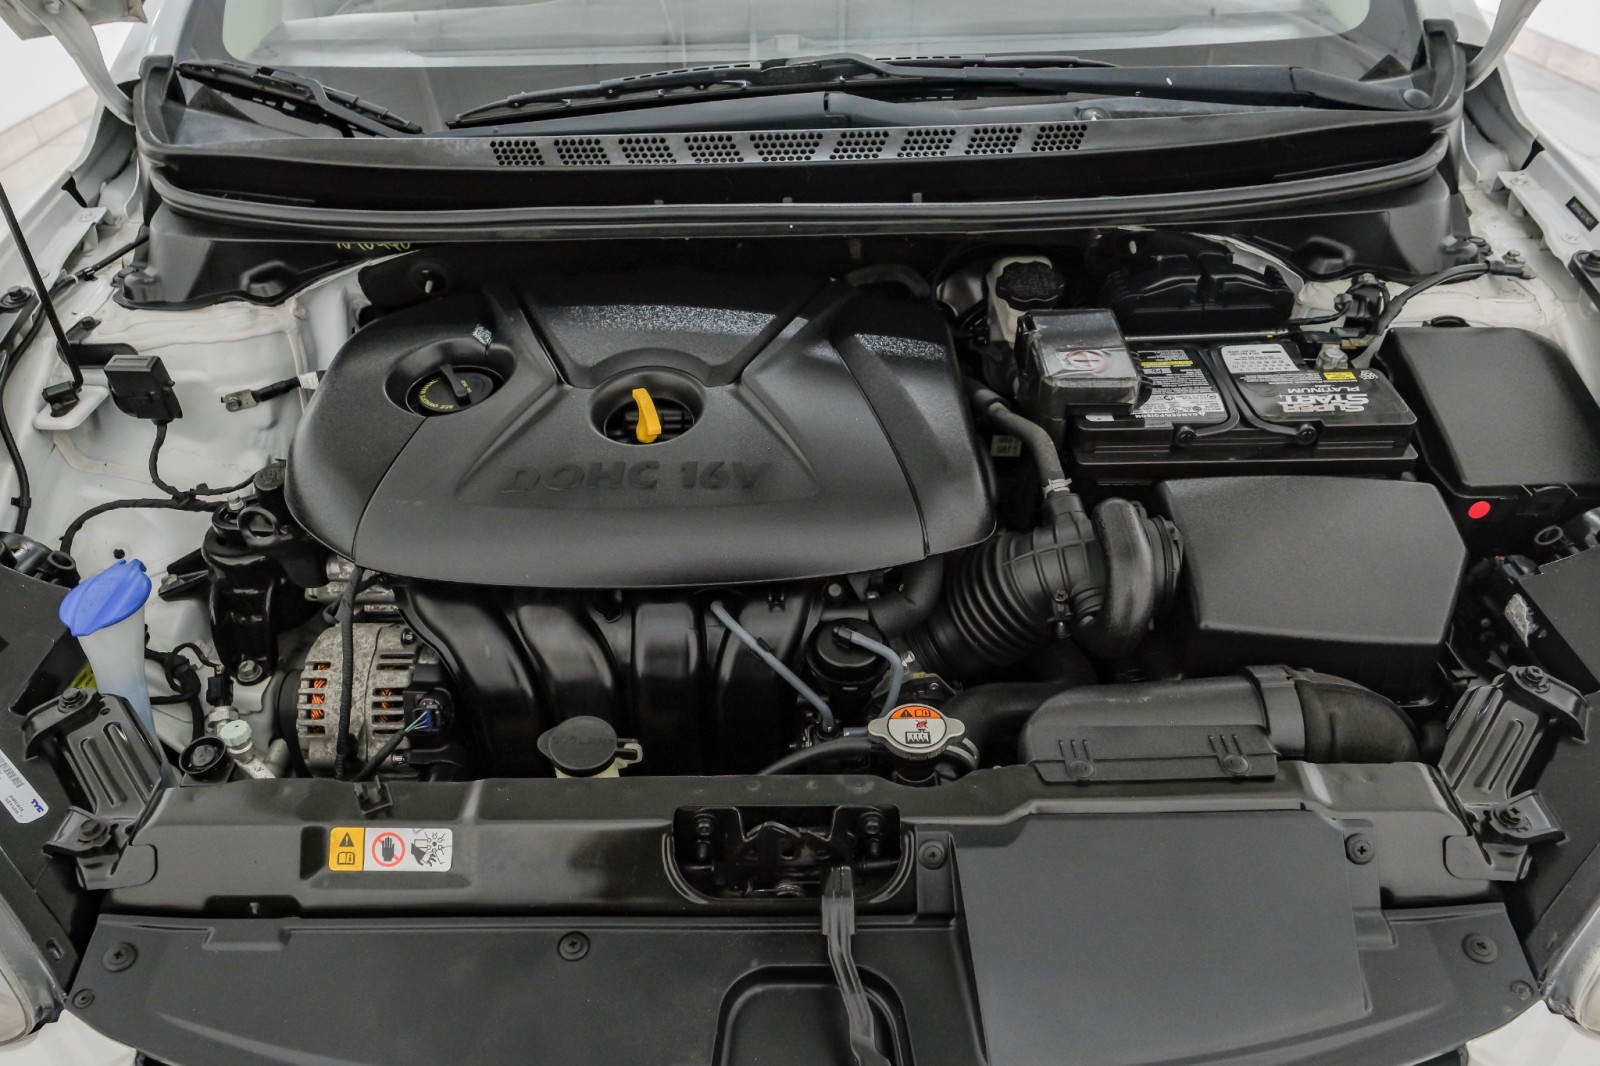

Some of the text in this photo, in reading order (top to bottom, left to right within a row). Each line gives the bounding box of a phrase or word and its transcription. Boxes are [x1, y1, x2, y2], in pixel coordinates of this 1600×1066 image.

[1287, 386, 1361, 394] PLATINUM
[1279, 393, 1370, 405] START
[1281, 403, 1365, 413] SUPER
[501, 460, 773, 493] DOHC 16V
[31, 798, 45, 814] TYC
